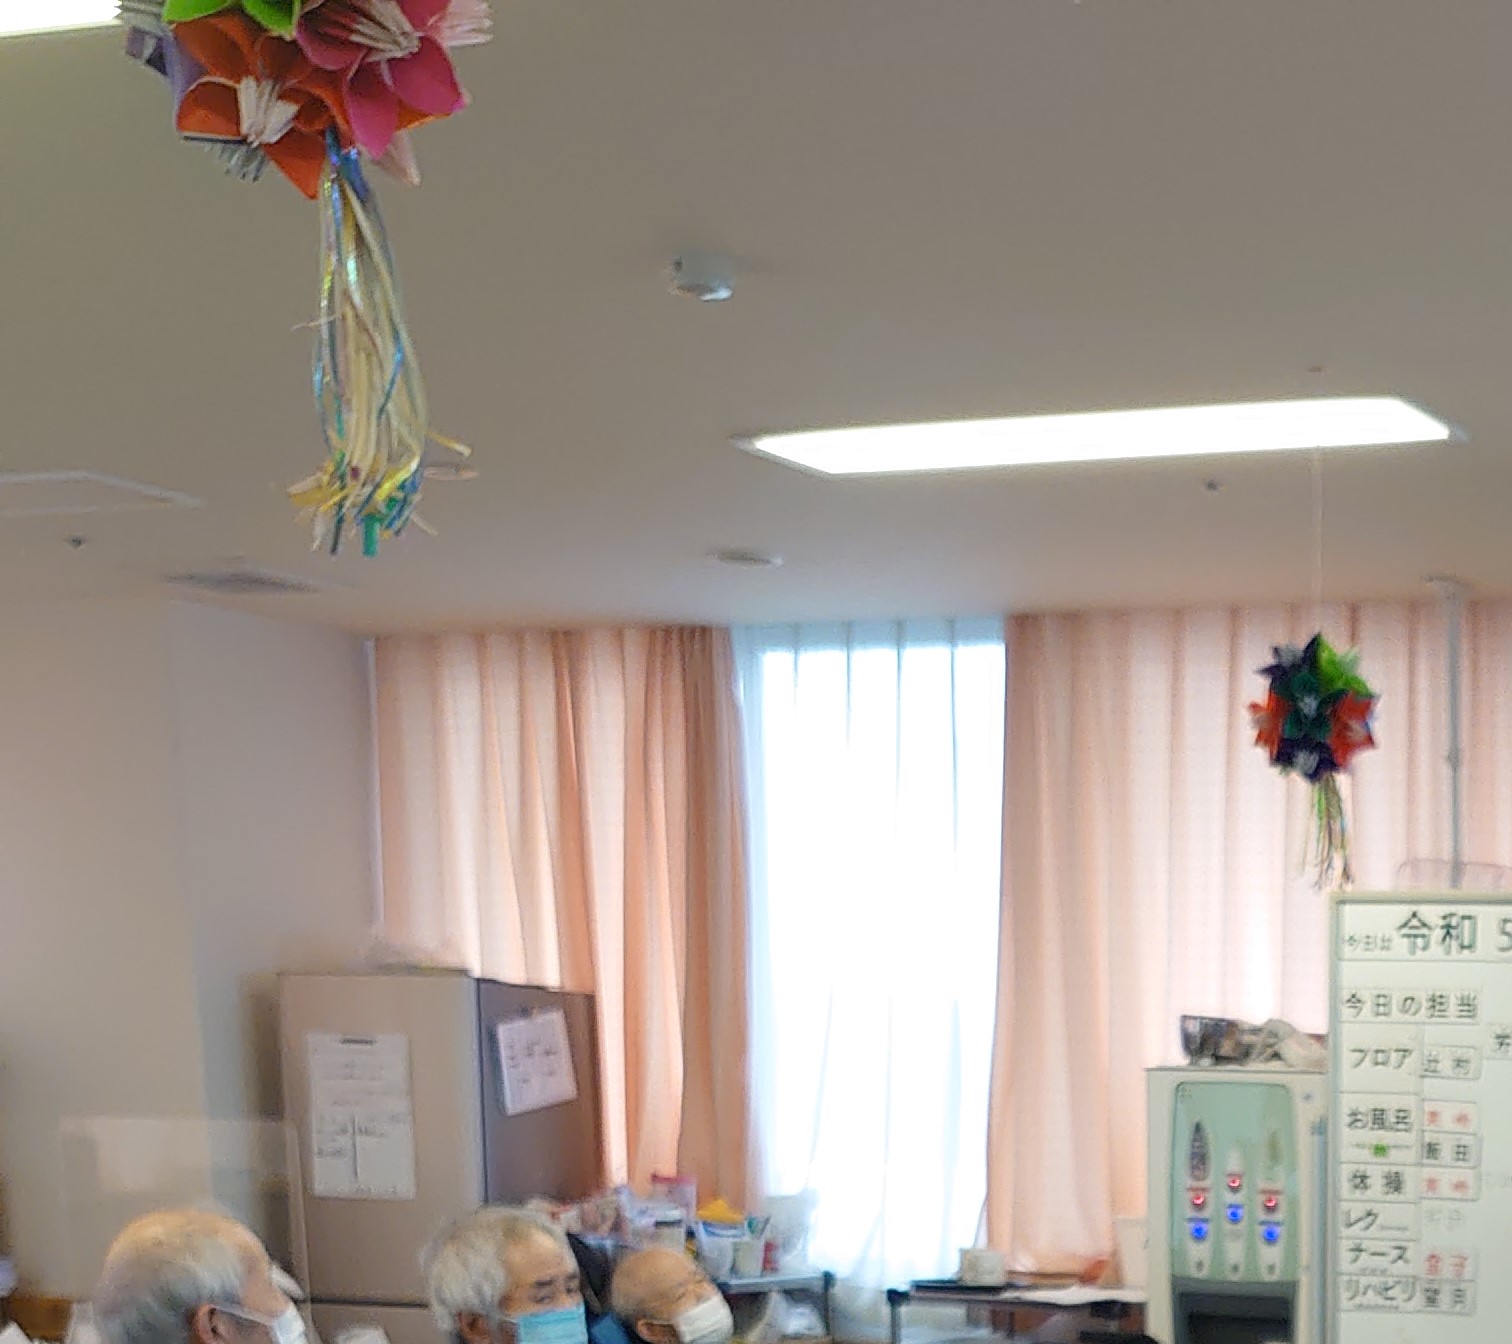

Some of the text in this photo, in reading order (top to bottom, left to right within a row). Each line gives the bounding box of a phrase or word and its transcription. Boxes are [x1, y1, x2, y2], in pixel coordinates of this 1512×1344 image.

[1345, 992, 1478, 1020] 今日の担当
[1350, 1047, 1413, 1070] フロア
[1344, 1208, 1379, 1231] レク
[1347, 1243, 1410, 1265] ナース
[1344, 1278, 1417, 1303] リハビリ
